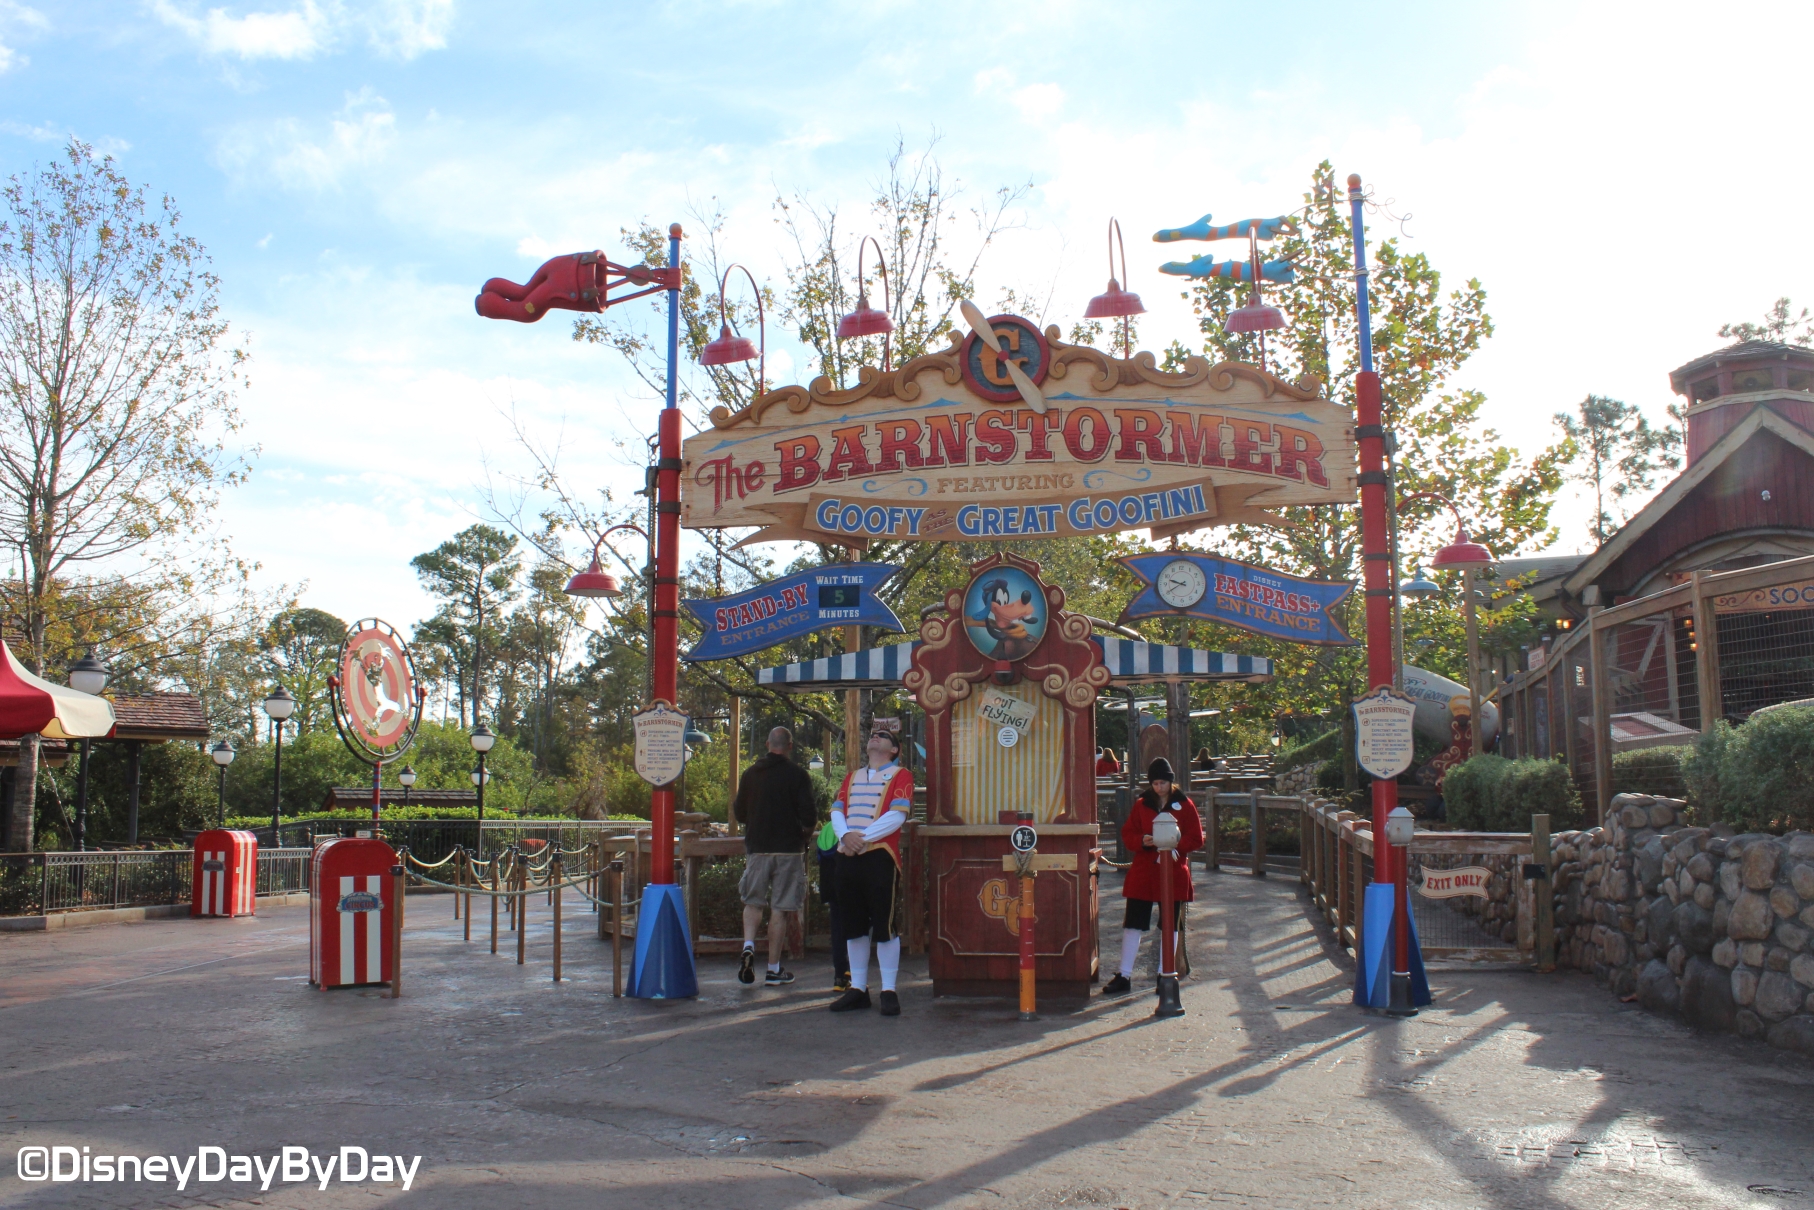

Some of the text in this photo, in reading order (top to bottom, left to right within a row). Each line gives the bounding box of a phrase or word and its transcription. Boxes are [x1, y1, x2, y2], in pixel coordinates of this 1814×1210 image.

[694, 406, 1330, 516] The BARNSTORMER
[936, 472, 1076, 494] FEATURING
[816, 498, 930, 536] GOOFY
[955, 503, 1064, 537] GREAT
[1067, 483, 1210, 531] GOOFINI
[815, 575, 864, 585] WAIT TIME
[1253, 575, 1282, 588] DISNEY
[834, 589, 844, 604] 5
[1213, 572, 1321, 615] FASTPASS+
[715, 582, 809, 633] STAND-BY
[818, 609, 860, 619] MINUTES
[1215, 594, 1321, 632] ENTRANCE
[720, 610, 810, 646] ENTRANCE
[993, 696, 1016, 710] OUT
[982, 704, 1028, 729] FLYING!
[1426, 874, 1483, 891] EXIT ONLY
